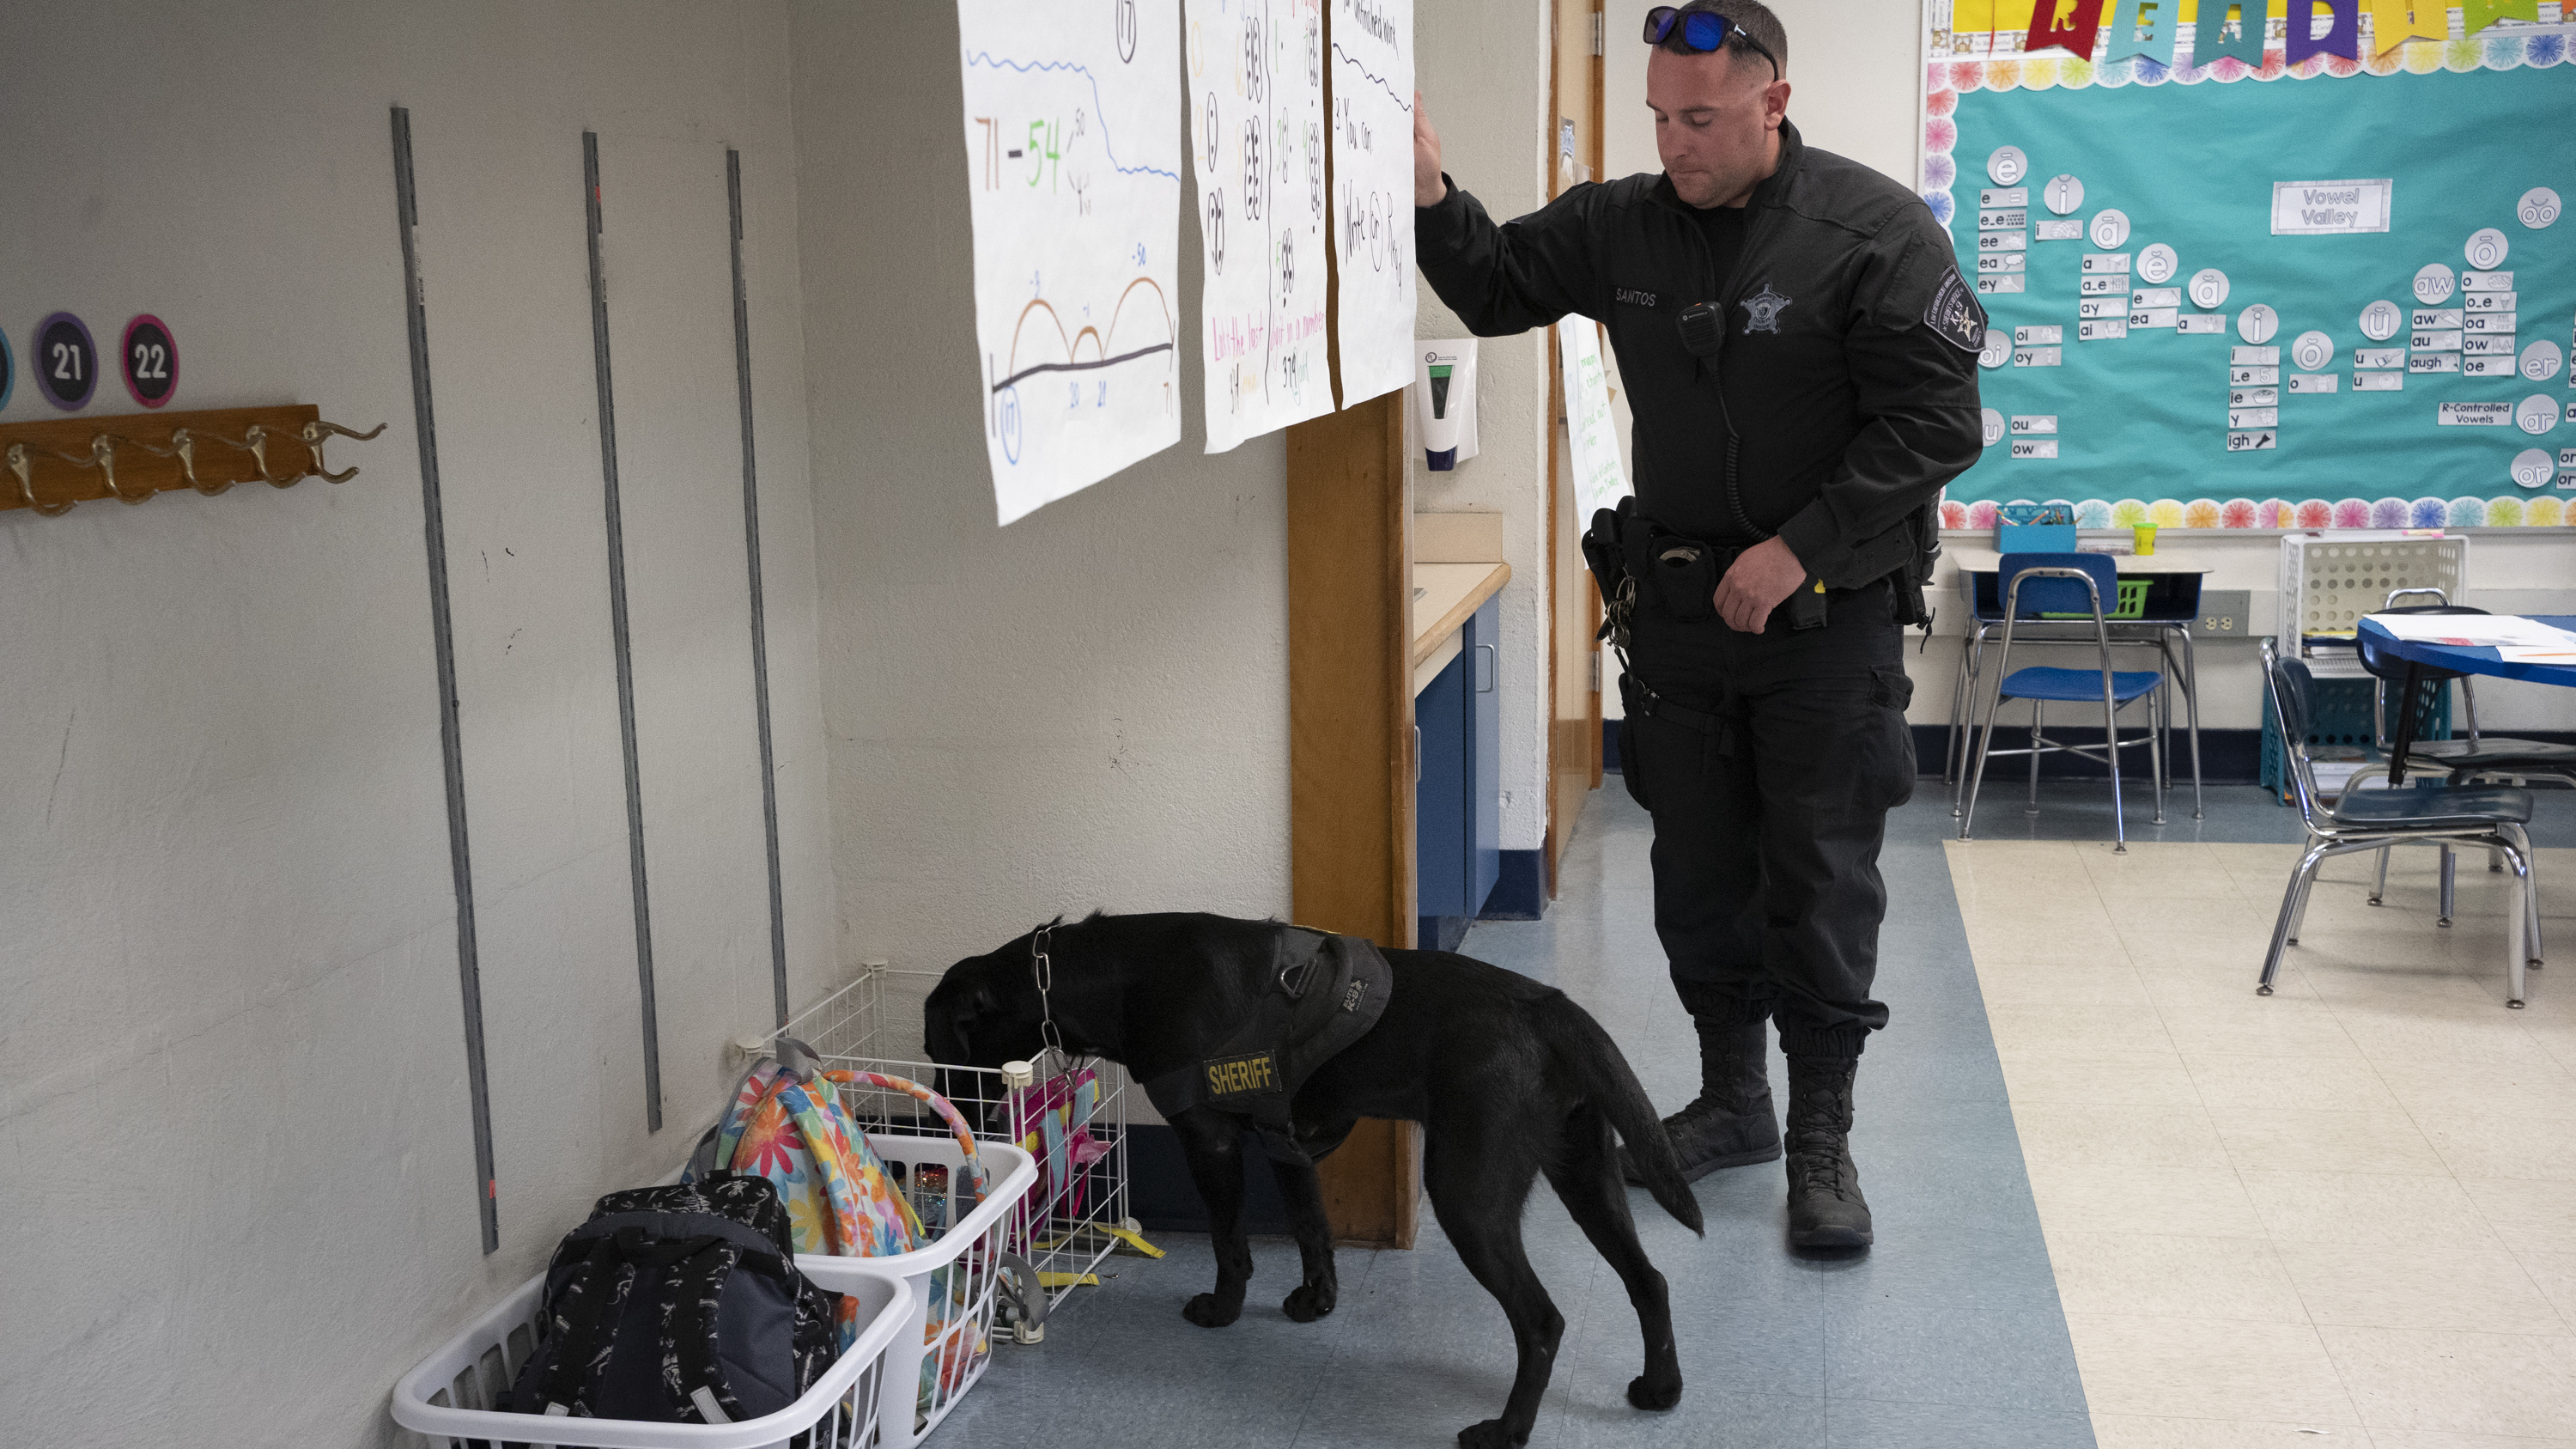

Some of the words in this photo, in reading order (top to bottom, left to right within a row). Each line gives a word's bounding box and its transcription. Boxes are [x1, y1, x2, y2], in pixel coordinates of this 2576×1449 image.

[1344, 97, 1358, 151] You
[1981, 193, 1990, 204] e
[2303, 187, 2360, 206] Vowel
[1343, 179, 1365, 266] Write
[2301, 208, 2358, 228] Valley
[2036, 224, 2040, 236] i
[1980, 236, 1999, 247] ee
[1979, 257, 1998, 269] ea
[2083, 259, 2093, 270] a
[1978, 279, 1997, 292] ey
[2413, 276, 2455, 295] aw
[2463, 277, 2472, 287] o
[1616, 288, 1656, 307] SANTOS
[2134, 294, 2143, 305] e
[2081, 302, 2099, 316] ay
[2130, 314, 2149, 325] ea
[2178, 319, 2187, 330] a
[2413, 314, 2437, 326] aw
[2465, 319, 2485, 329] oa
[1248, 309, 1263, 351] last
[2016, 329, 2029, 342] oi
[2081, 324, 2093, 336] ai
[2412, 337, 2431, 348] au
[2464, 340, 2488, 350] ow
[2015, 352, 2033, 366] oy
[2231, 349, 2236, 361] i
[2355, 353, 2364, 364] u
[52, 342, 82, 381] 21
[134, 344, 167, 379] 22
[2410, 356, 2442, 370] augh
[2465, 362, 2485, 372] oe
[2524, 356, 2559, 377] er
[2290, 379, 2299, 389] o
[2354, 376, 2363, 387] u
[2231, 393, 2243, 404] ie
[2442, 402, 2510, 413] R-Controlled
[2231, 414, 2239, 427] y
[2456, 414, 2494, 424] Vowels
[2523, 411, 2555, 432] ar
[2012, 420, 2029, 431] ou
[2228, 435, 2250, 449] igh
[2013, 444, 2034, 455] ow
[2518, 466, 2549, 484] or
[1347, 989, 1359, 1012] K-9
[1208, 1056, 1272, 1095] SHERIFF
